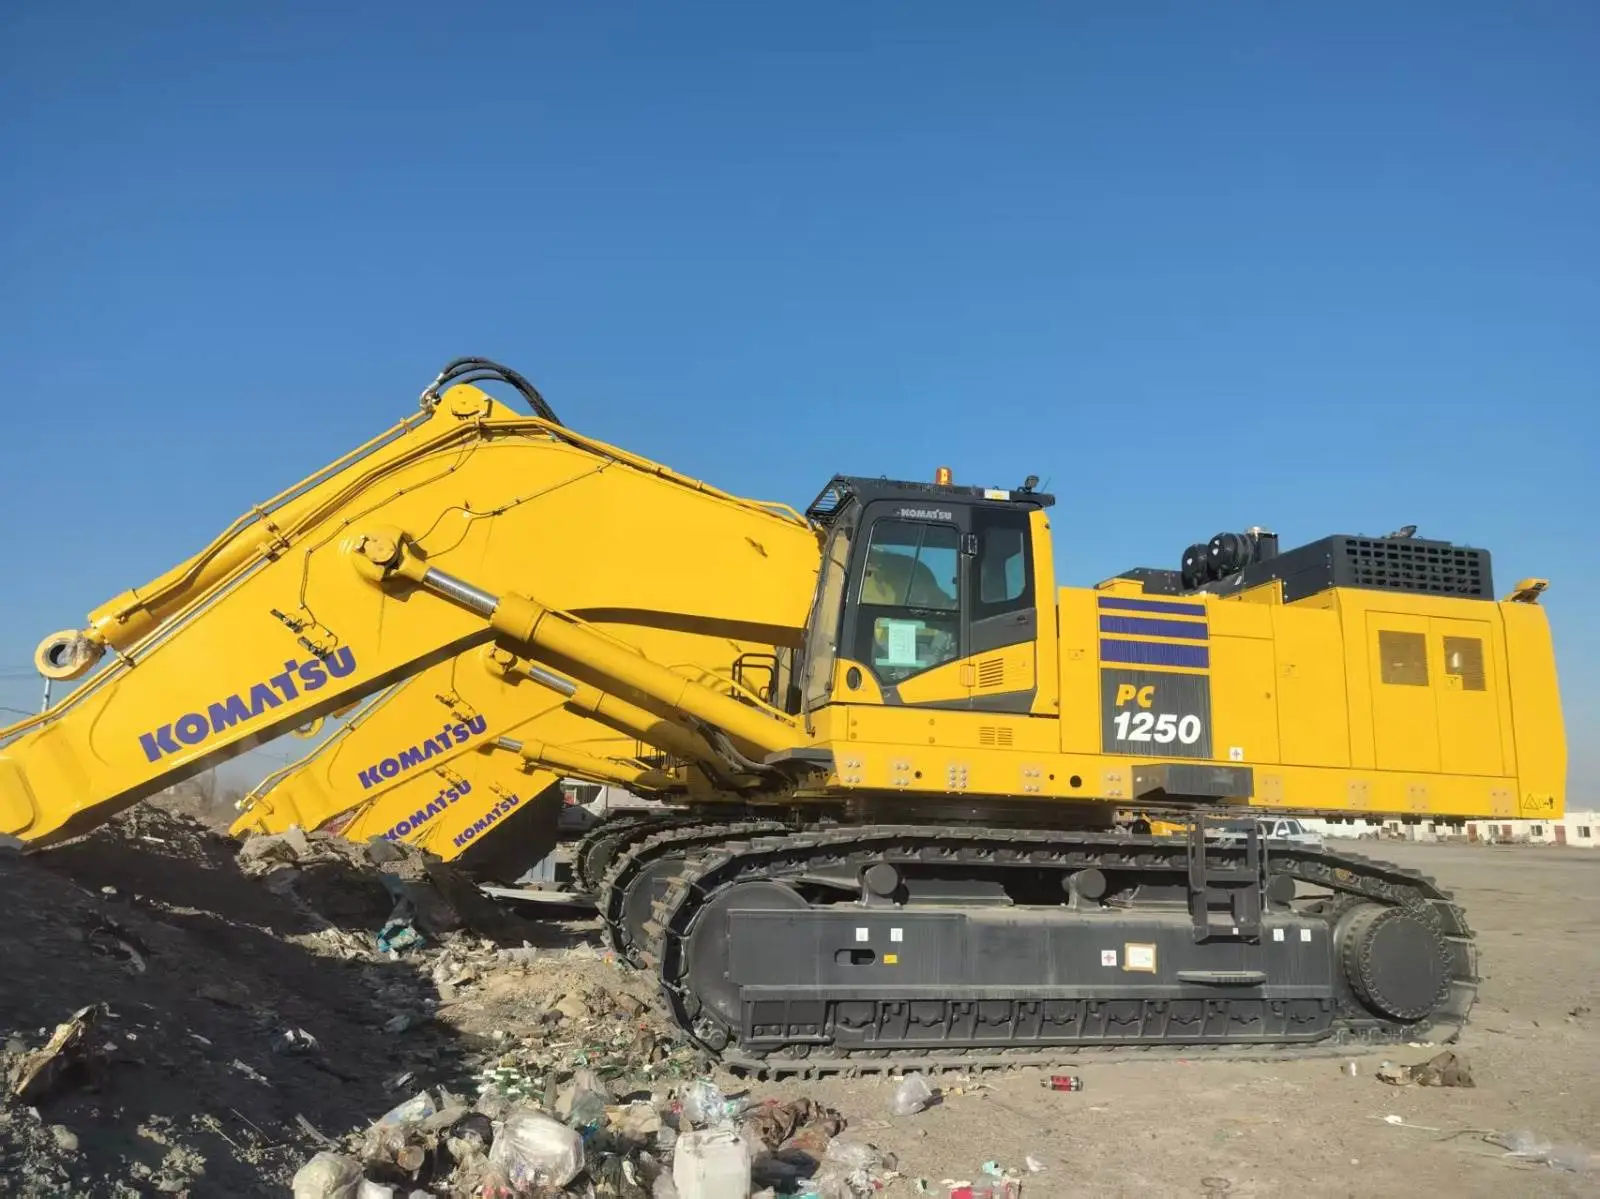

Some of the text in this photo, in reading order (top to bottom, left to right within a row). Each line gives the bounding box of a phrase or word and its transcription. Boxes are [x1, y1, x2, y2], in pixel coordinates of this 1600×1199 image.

[901, 508, 952, 520] KOMATSU
[139, 645, 357, 763] KOMATSU
[1116, 683, 1156, 708] PC
[1114, 711, 1201, 744] 1250
[357, 714, 488, 790] KOMATSU
[453, 794, 520, 847] KOMATSU
